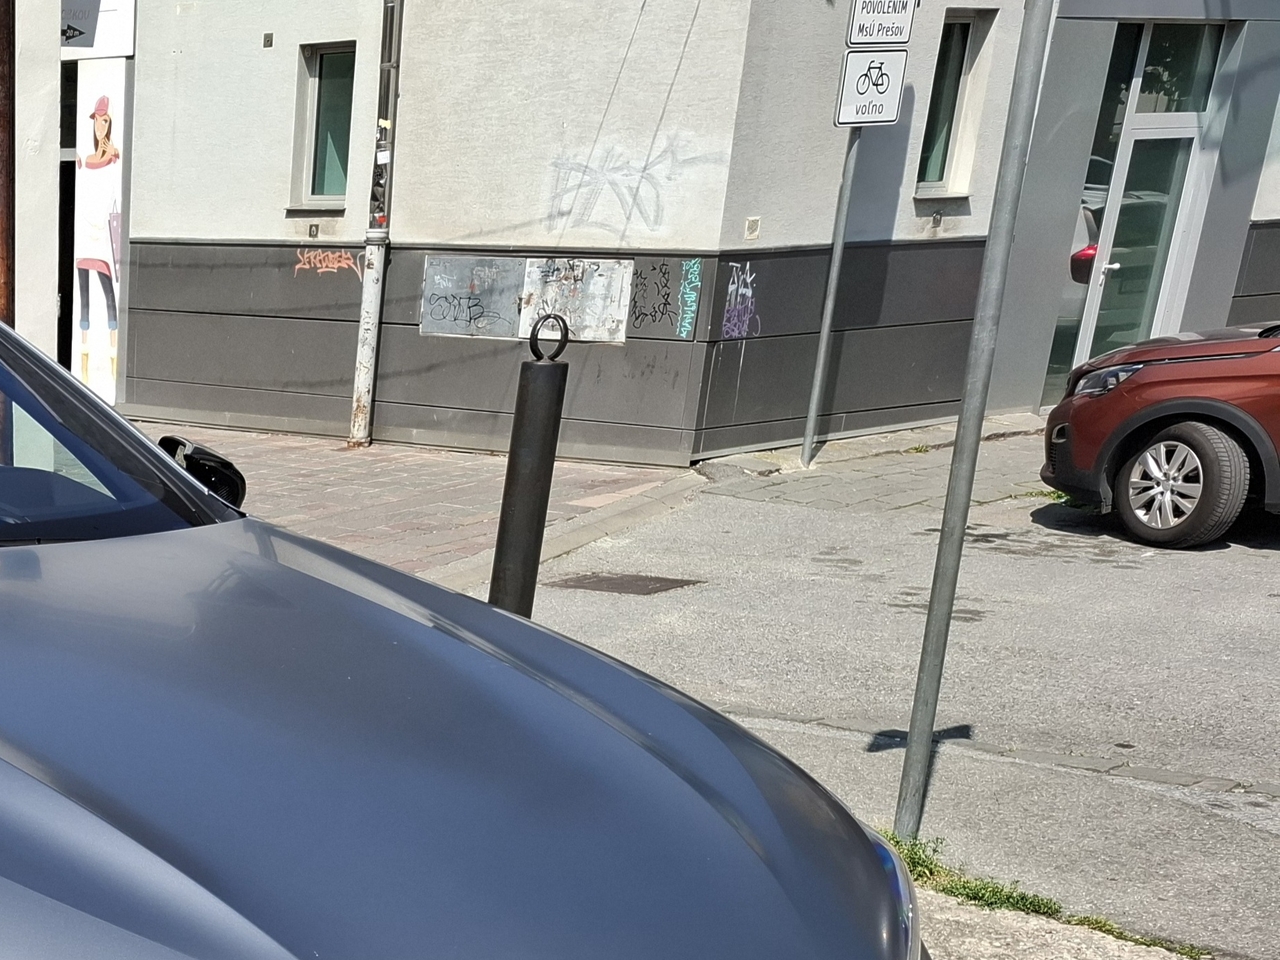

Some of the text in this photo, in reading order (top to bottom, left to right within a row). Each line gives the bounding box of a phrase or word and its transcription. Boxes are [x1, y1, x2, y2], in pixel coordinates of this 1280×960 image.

[856, 18, 905, 37] MsÚ Prešov
[855, 100, 884, 116] voľno
